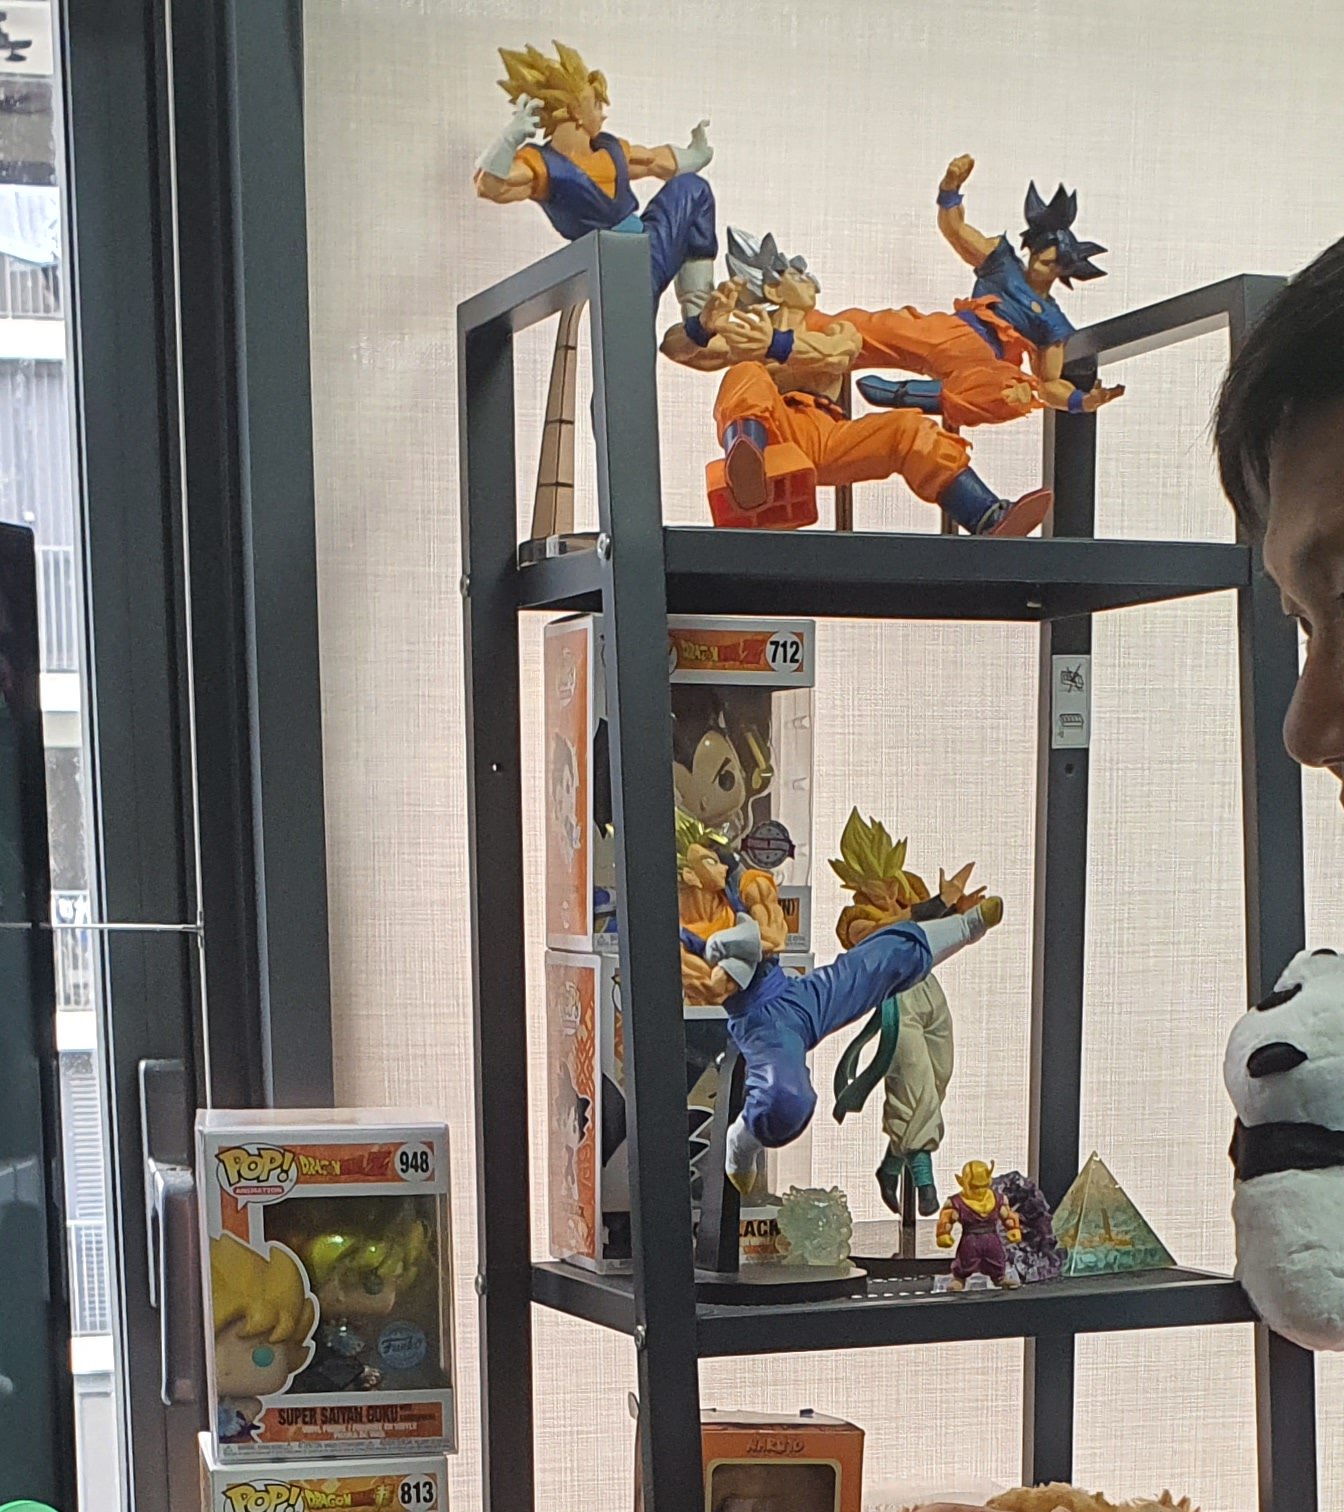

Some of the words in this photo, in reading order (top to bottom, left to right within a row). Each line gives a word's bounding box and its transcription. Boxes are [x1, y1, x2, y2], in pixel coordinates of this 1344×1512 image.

[769, 640, 800, 664] 712
[216, 1147, 296, 1186] POP!
[399, 1150, 430, 1173] 948
[278, 1408, 317, 1426] SUPER
[321, 1406, 364, 1424] SAIYAN
[400, 1481, 435, 1504] 813
